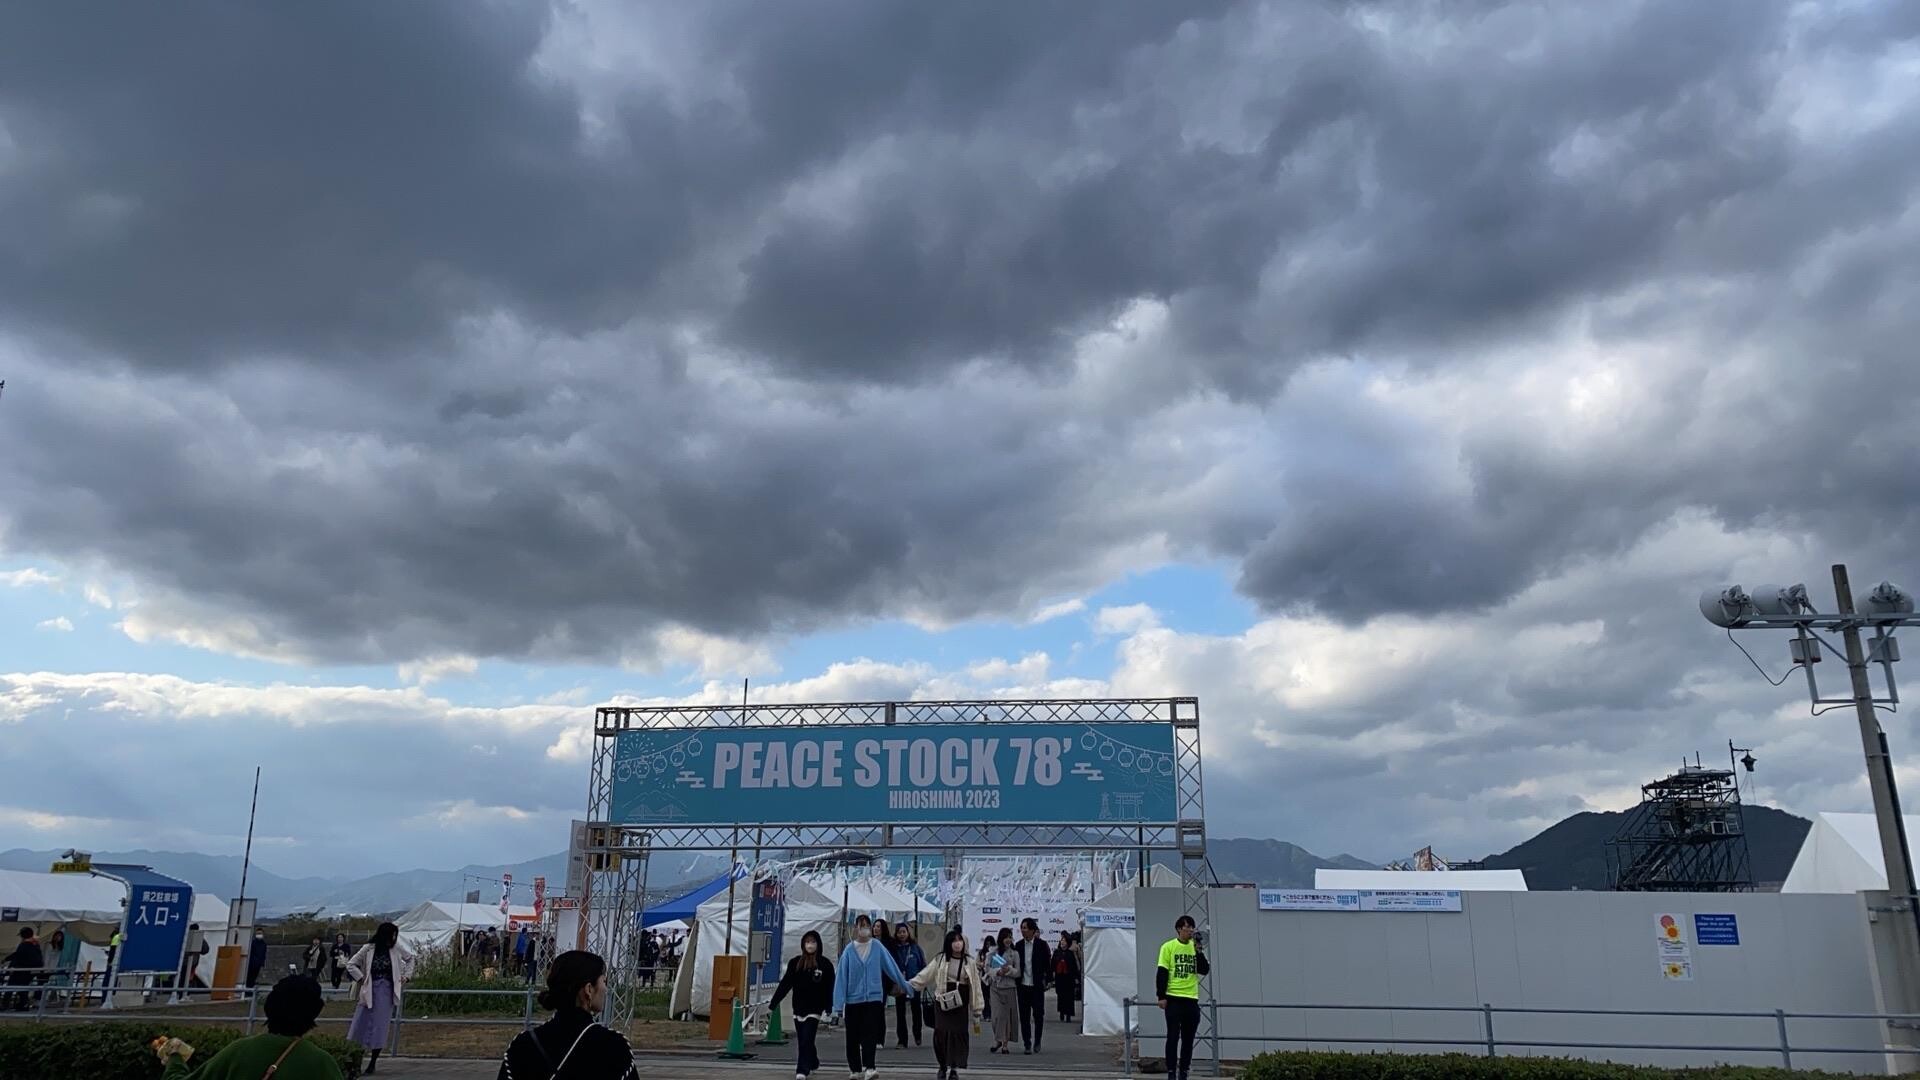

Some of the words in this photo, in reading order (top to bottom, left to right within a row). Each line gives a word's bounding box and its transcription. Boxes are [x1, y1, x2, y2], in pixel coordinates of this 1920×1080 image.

[712, 739, 843, 789] PEACE
[854, 738, 1001, 787] STOCK
[888, 790, 964, 810] HIROSHIMA
[965, 789, 1000, 809] 2023
[142, 891, 179, 903] 第2駐車場
[135, 905, 169, 926] 入口
[1174, 954, 1196, 963] PEACE
